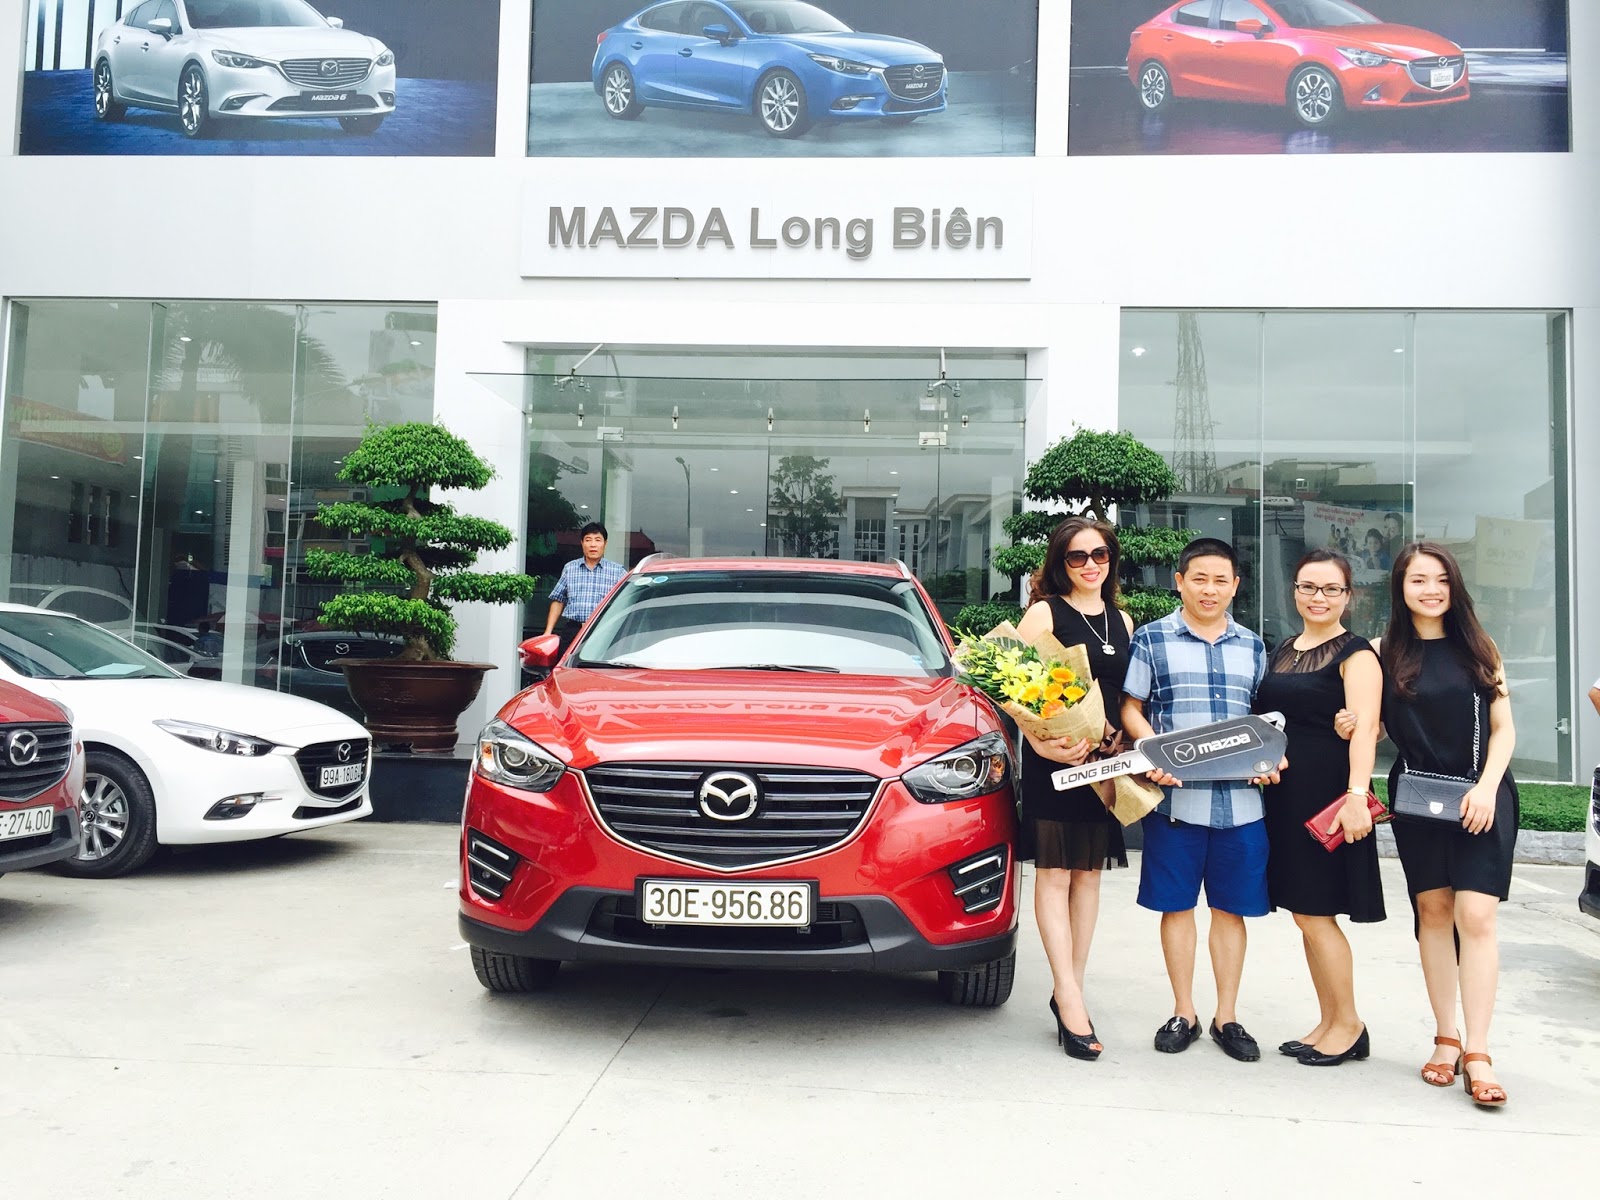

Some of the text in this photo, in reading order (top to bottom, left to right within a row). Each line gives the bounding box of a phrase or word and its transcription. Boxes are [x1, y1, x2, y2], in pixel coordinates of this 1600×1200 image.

[548, 206, 1004, 260] MAZDA Long Biên
[1060, 760, 1132, 785] LONG BIÊN
[650, 888, 803, 920] 30E-956.86
